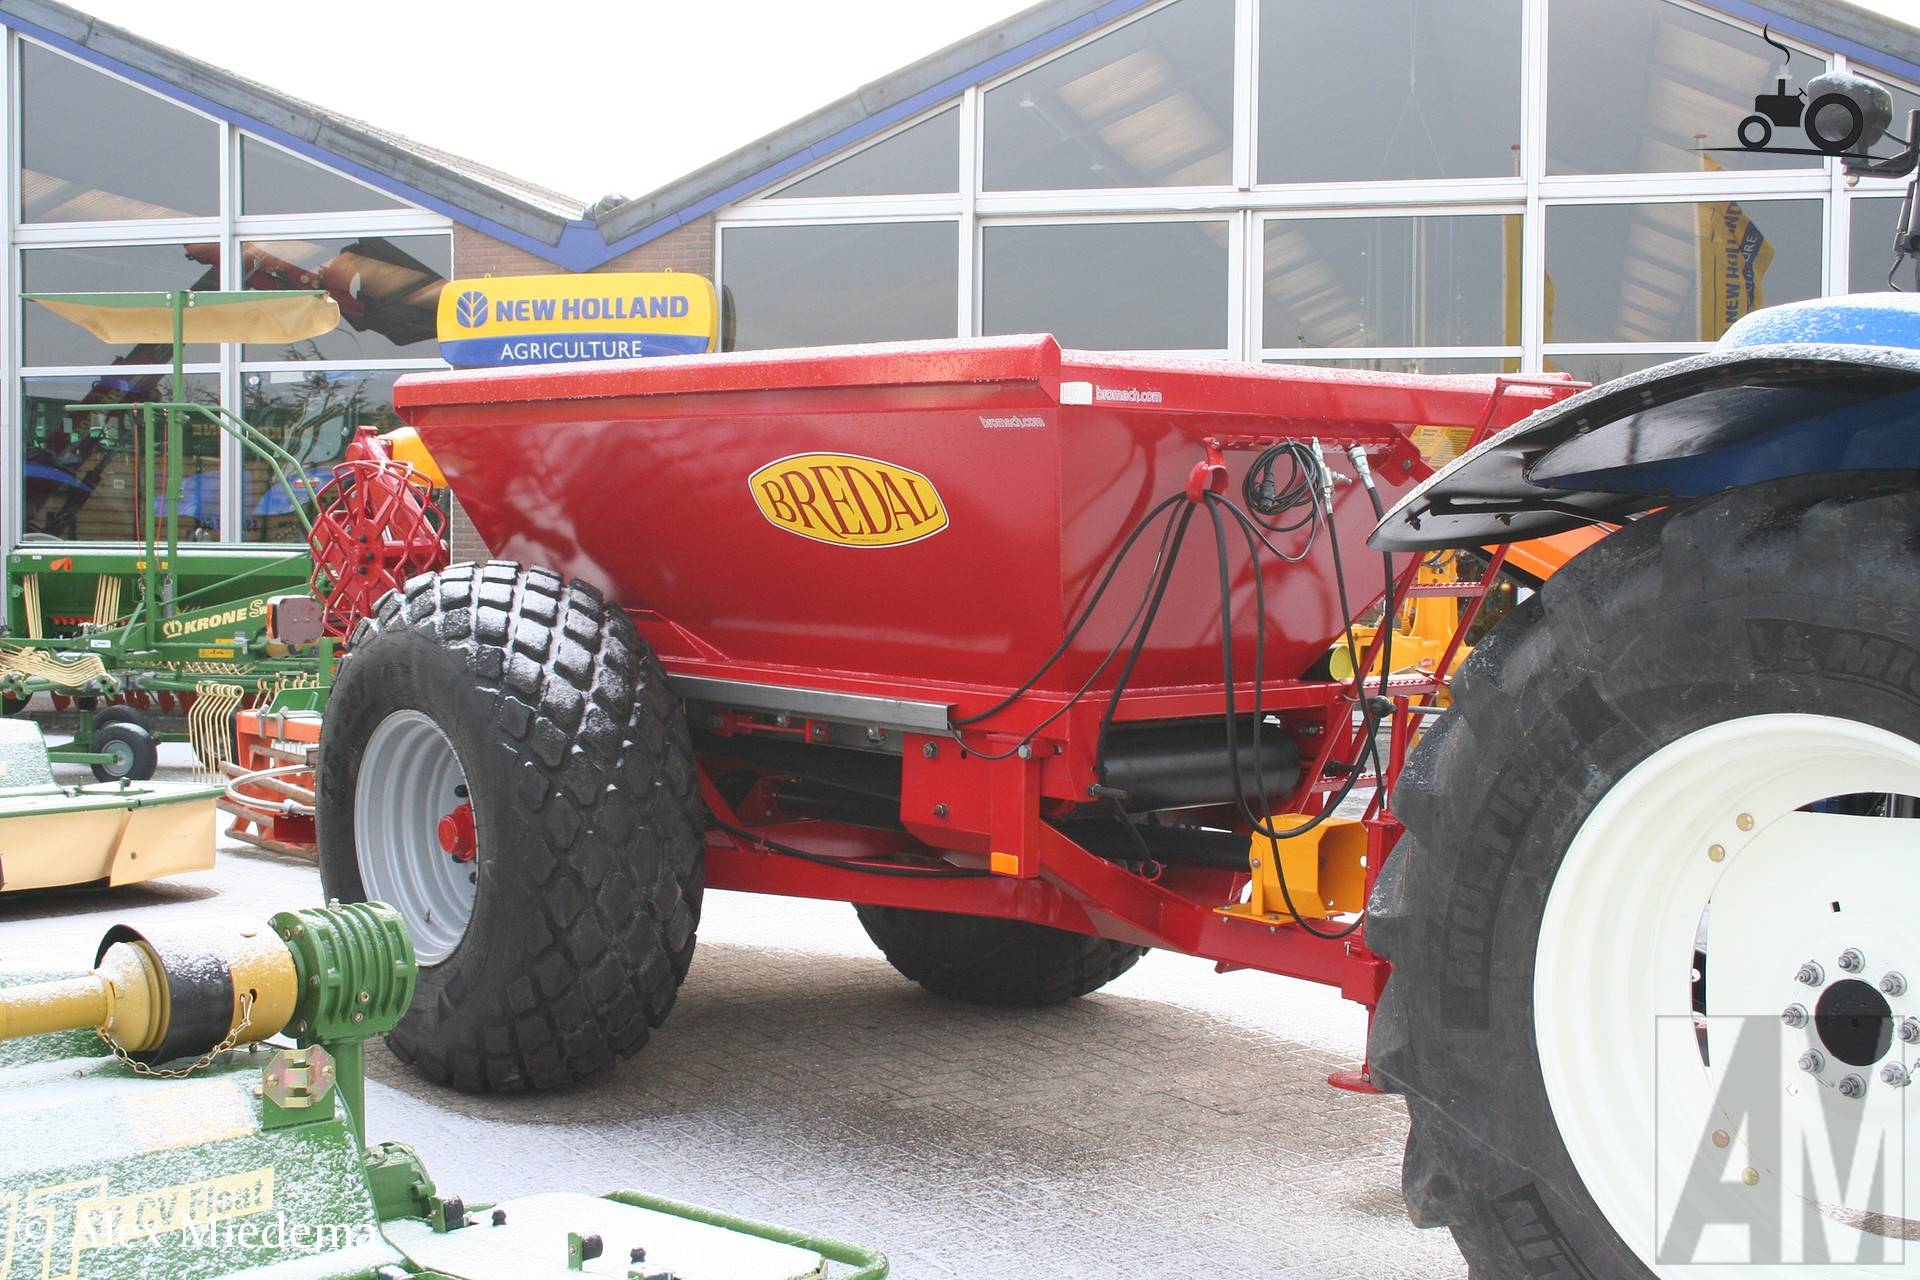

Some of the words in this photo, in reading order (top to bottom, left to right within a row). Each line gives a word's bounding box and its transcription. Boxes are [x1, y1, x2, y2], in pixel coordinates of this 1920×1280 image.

[496, 299, 556, 321] NEW
[562, 295, 689, 320] HOLLAND
[500, 340, 642, 361] AGRICULTURE
[760, 465, 939, 539] BREDAL
[184, 607, 248, 634] KRONE
